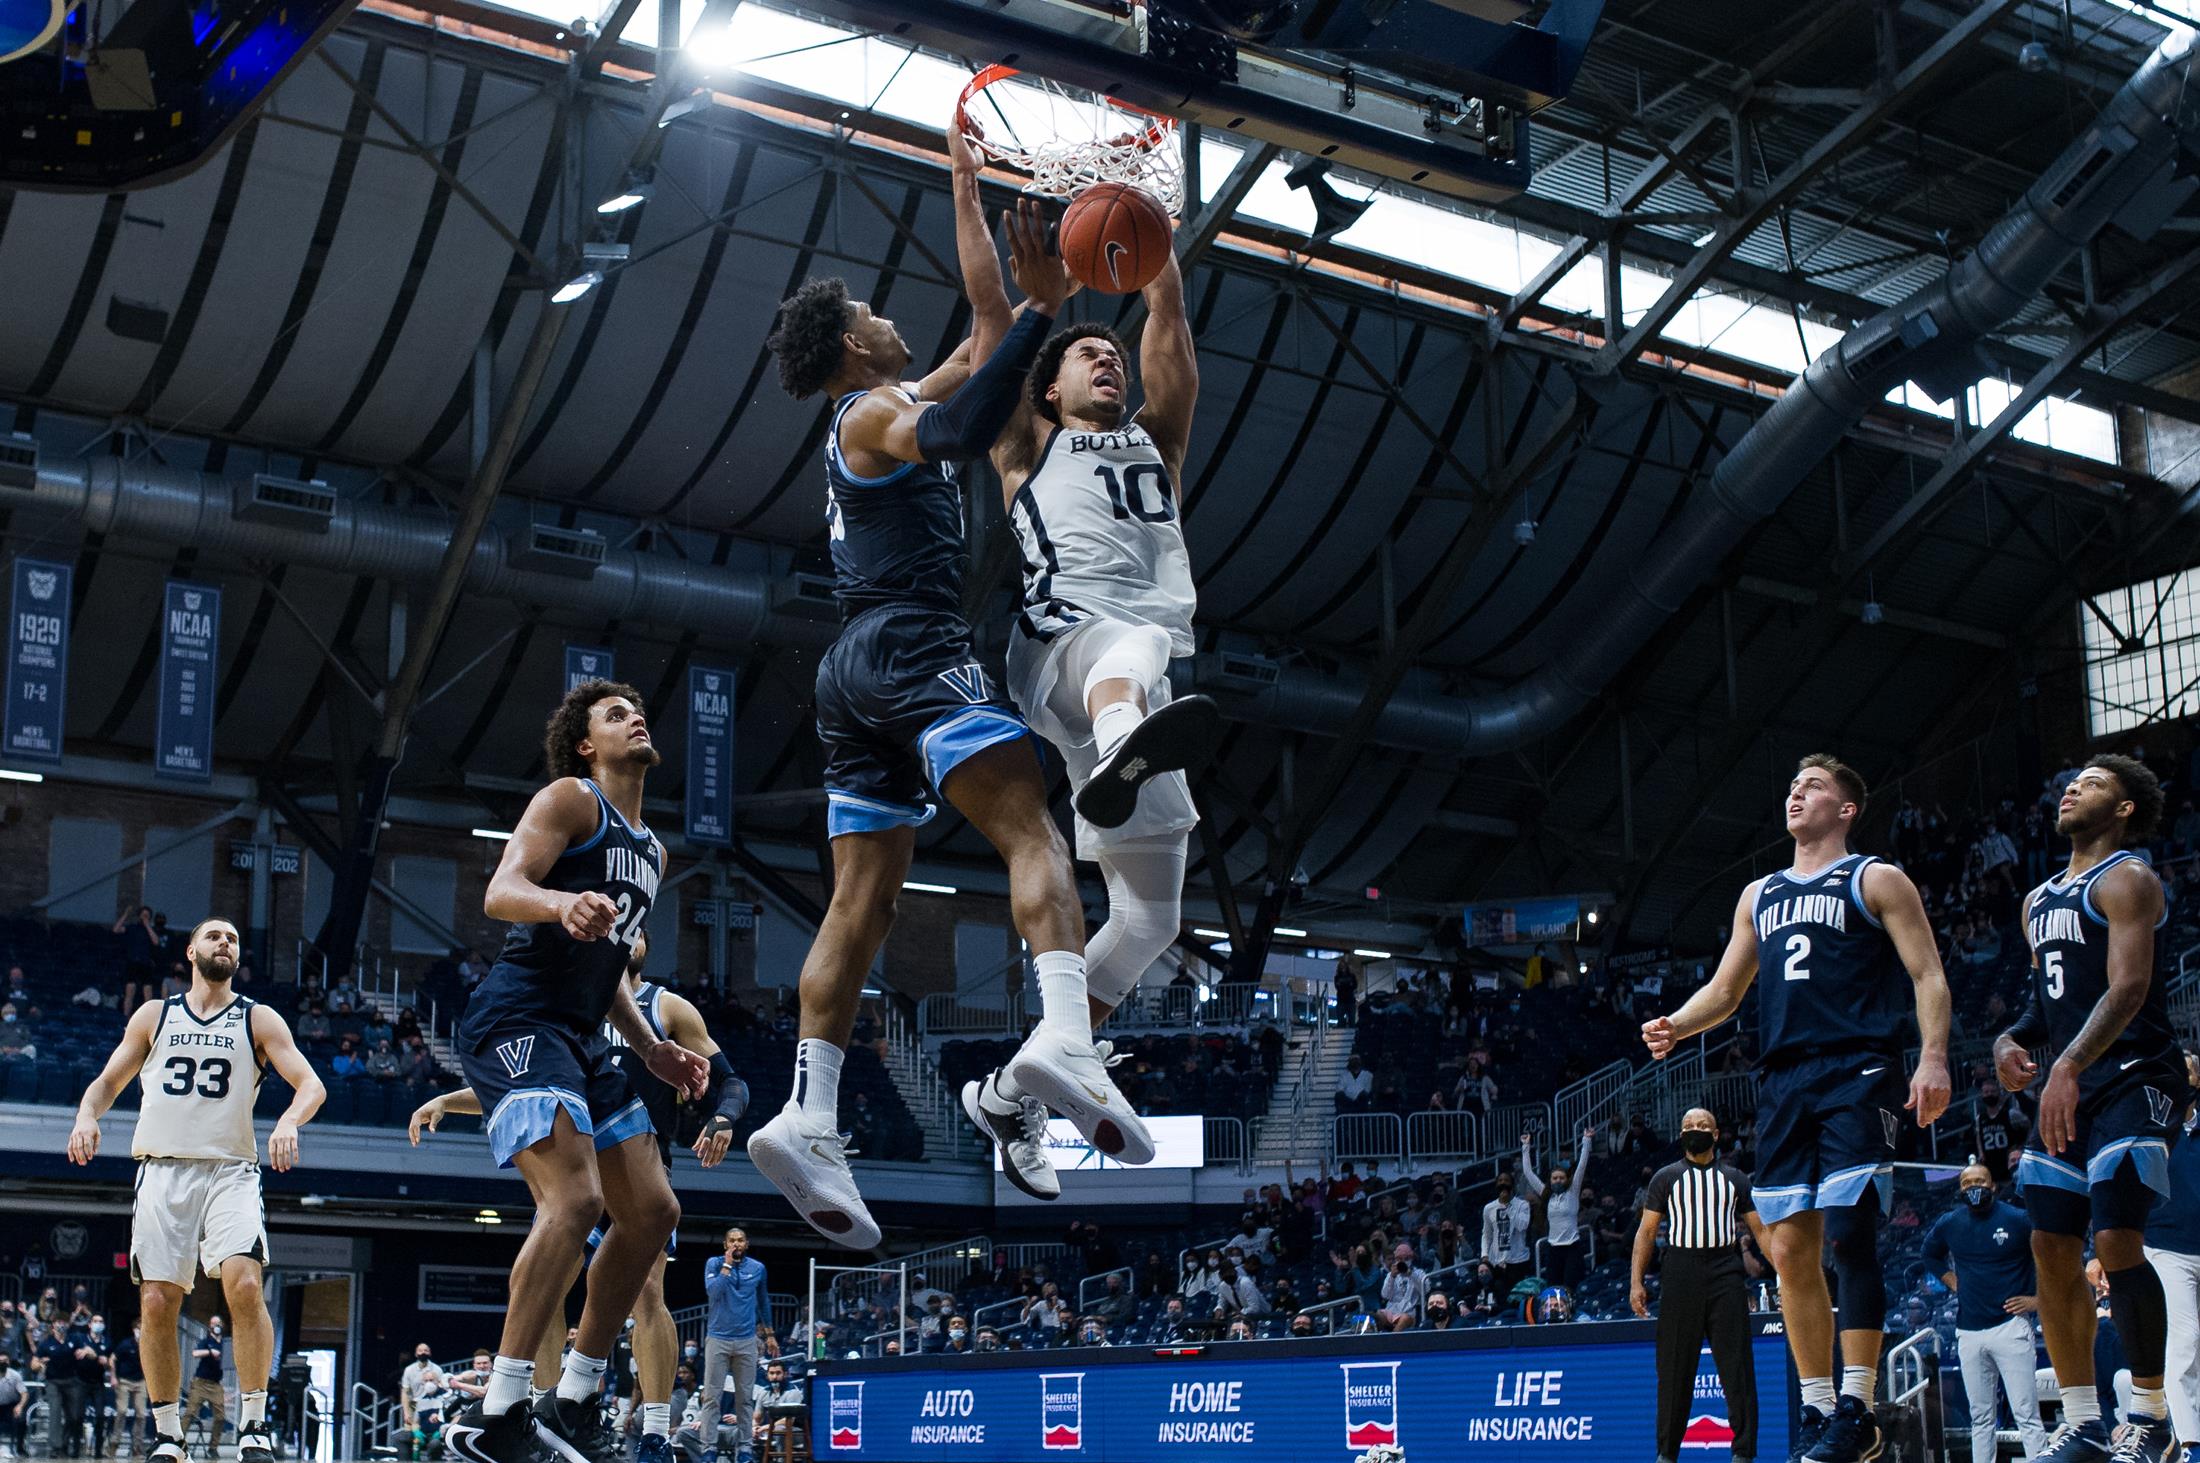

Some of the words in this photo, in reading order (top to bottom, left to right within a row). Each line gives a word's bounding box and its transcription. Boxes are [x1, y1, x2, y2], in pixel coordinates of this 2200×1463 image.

[1070, 434, 1154, 454] BUTLE
[1094, 463, 1176, 523] 10
[19, 613, 60, 646] 1929
[170, 610, 211, 639] NCAA
[23, 681, 48, 702] 17-2
[694, 690, 729, 717] NCAA
[274, 857, 299, 873] 202
[608, 892, 647, 959] 24
[1759, 894, 1846, 942] VILLANOVA
[1609, 949, 1656, 968] RESTROOMS
[1784, 934, 1811, 981] 2
[2045, 950, 2065, 1000] 5
[168, 1033, 235, 1050] BUTLER
[163, 1057, 232, 1098] 33
[1522, 1116, 1545, 1133] 204
[1984, 1132, 2009, 1150] 20
[1762, 1322, 1783, 1334] ANC
[1045, 1392, 1078, 1404] SHELTER
[1169, 1381, 1242, 1413] HOME
[1349, 1385, 1393, 1398] SHELTER
[1495, 1370, 1563, 1406] LIFE
[832, 1399, 860, 1409] SHELTER
[920, 1389, 975, 1418] AUTO
[1350, 1398, 1393, 1407] INSURANCE
[911, 1425, 985, 1444] INSURANCE
[1158, 1422, 1255, 1443] INSURANCE
[1468, 1416, 1593, 1441] INSURANCE
